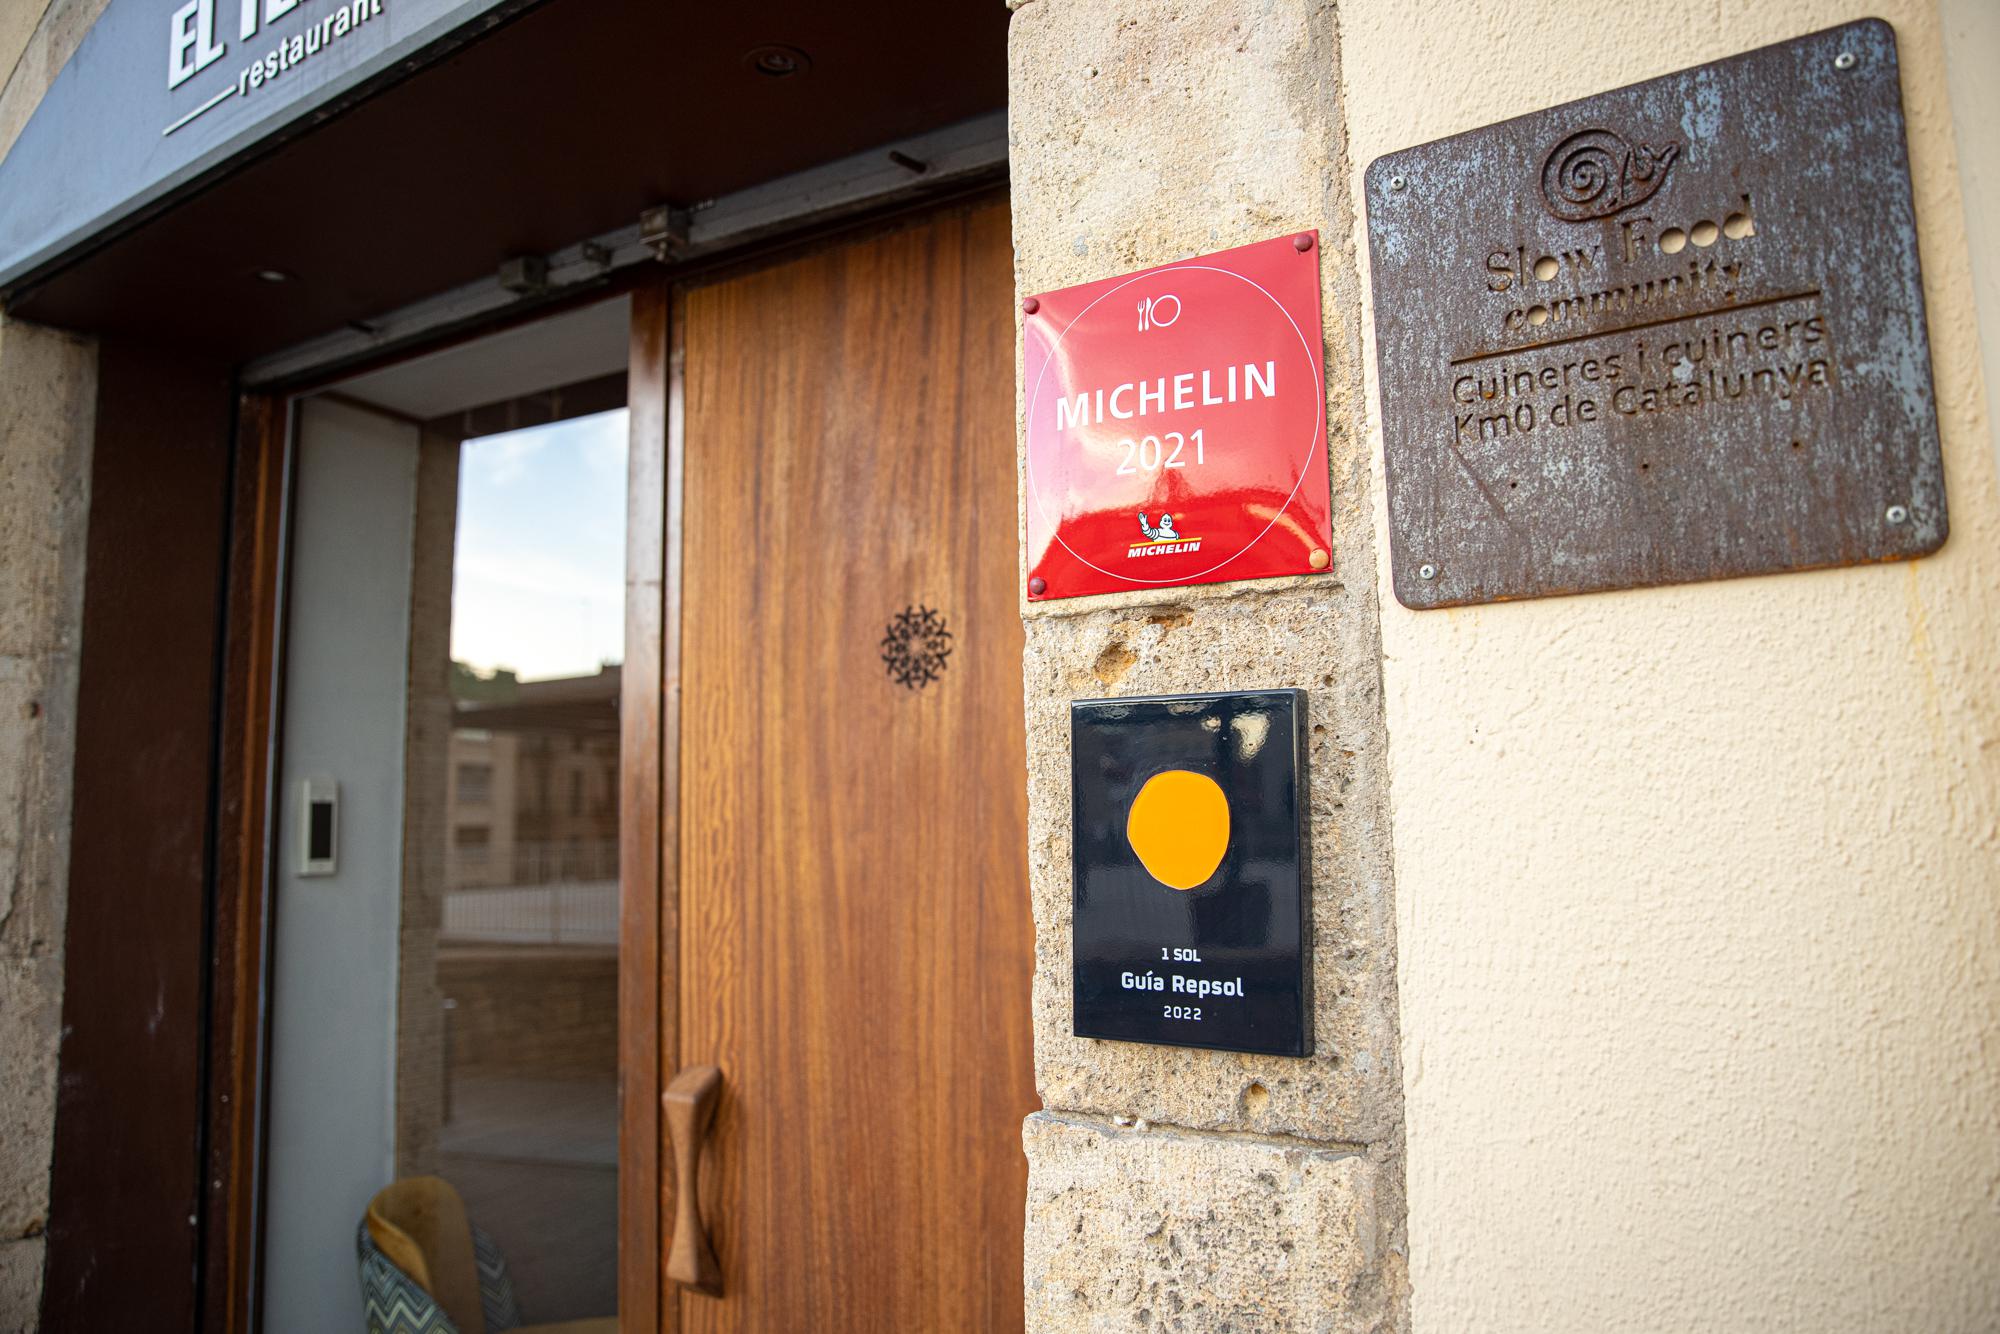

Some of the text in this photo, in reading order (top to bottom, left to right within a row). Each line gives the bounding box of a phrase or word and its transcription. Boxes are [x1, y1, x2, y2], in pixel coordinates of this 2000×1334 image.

[168, 0, 225, 91] EL
[1486, 194, 1757, 292] Slow Food
[1505, 261, 1744, 331] community
[1452, 315, 1826, 404] Cuineres i cuiners
[1549, 395, 1597, 428] de
[1612, 357, 1832, 416] Catalunya
[1056, 360, 1276, 432] MICHELIN
[1116, 428, 1205, 476] 2021
[1127, 541, 1201, 558] MICHELIN
[1121, 970, 1244, 999] Guía Repsol
[1161, 947, 1202, 962] 1 SOL
[1163, 1005, 1202, 1021] 2022
